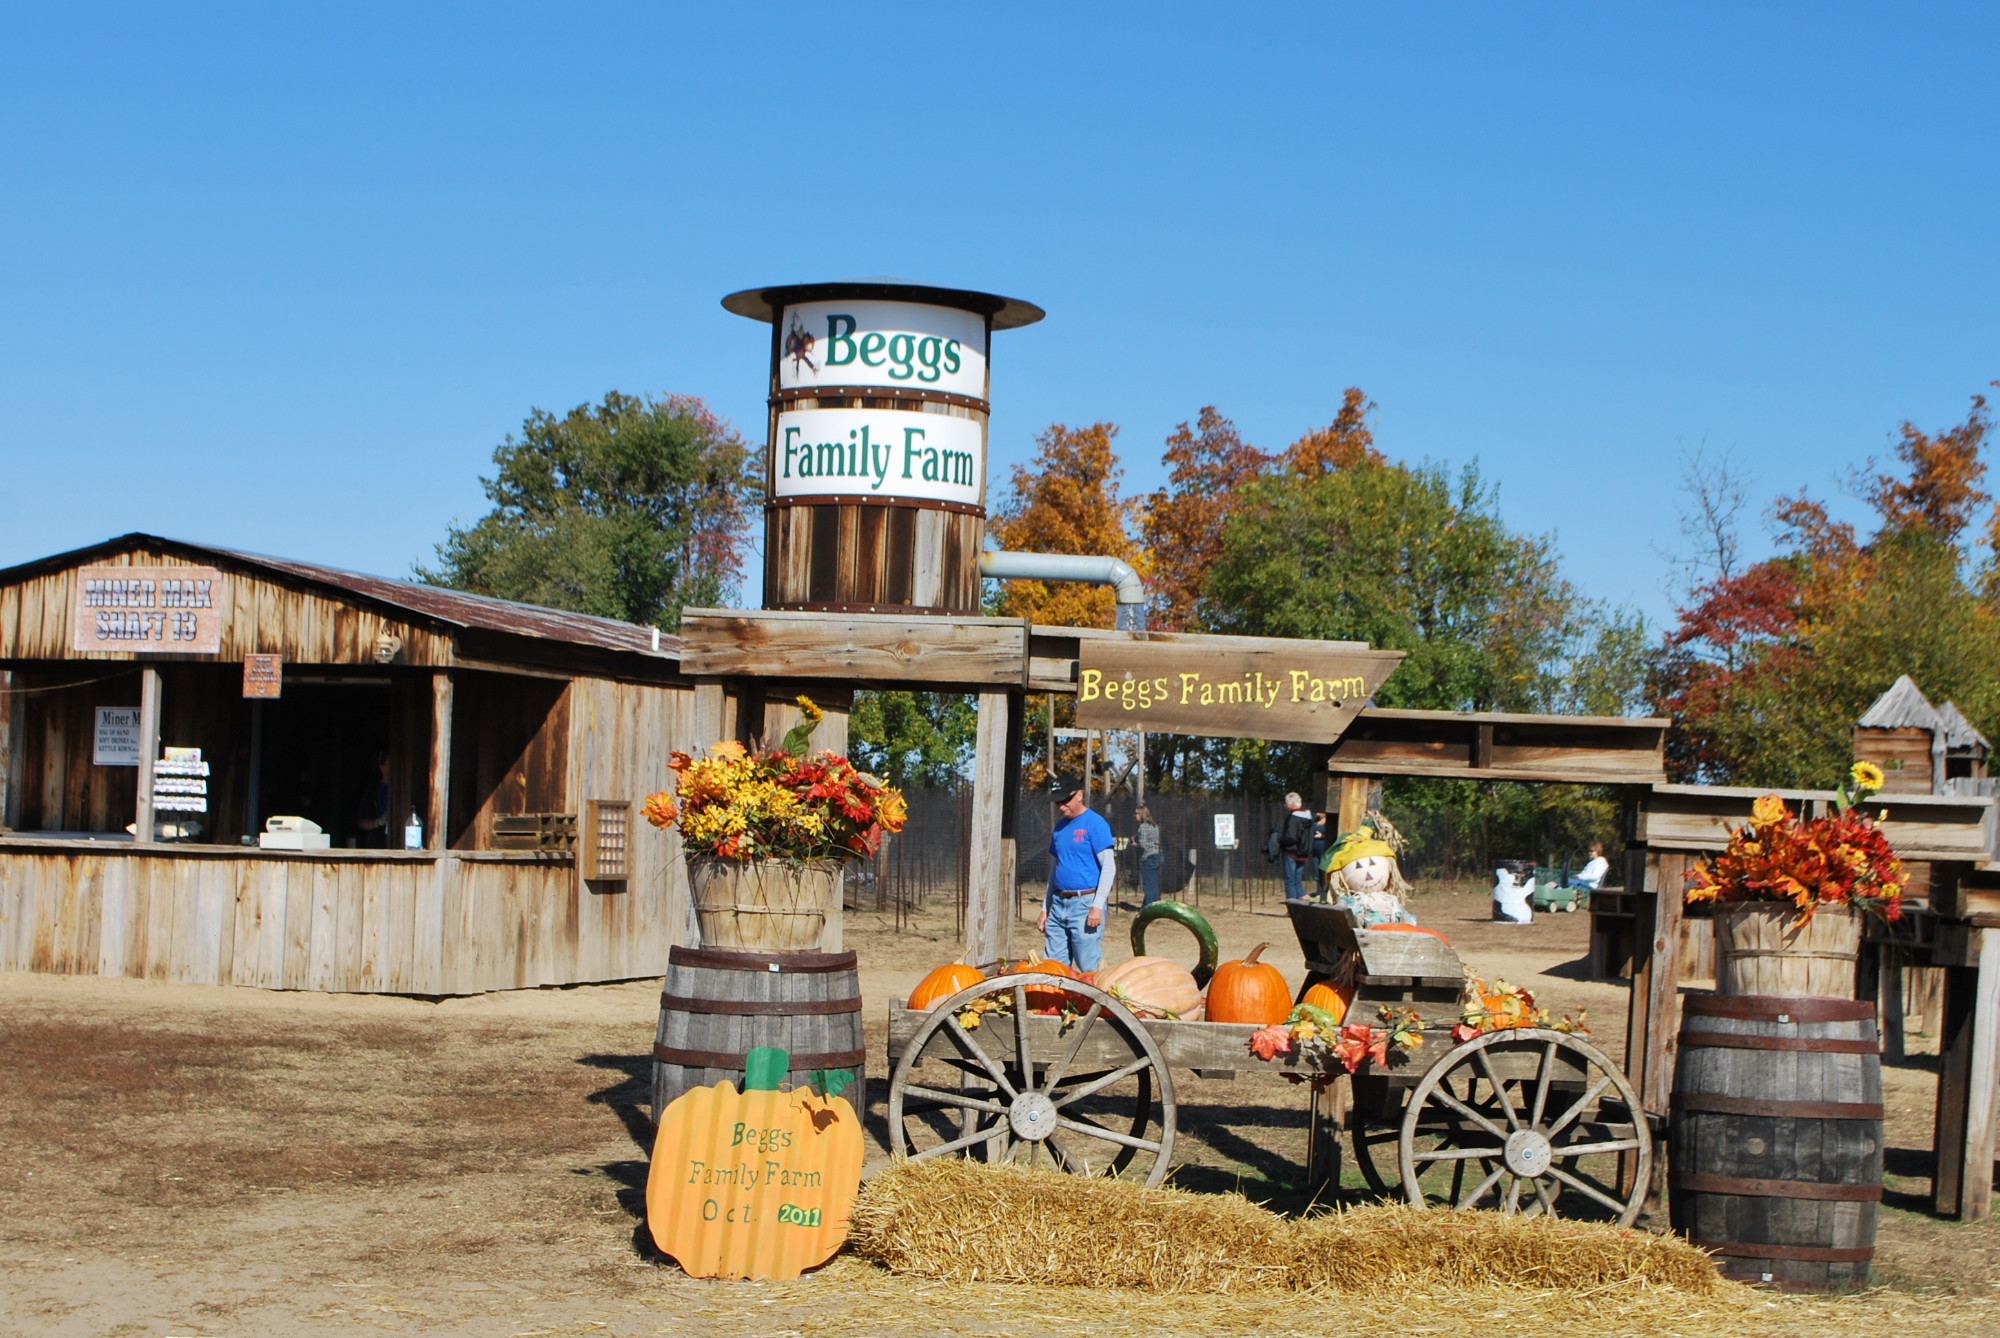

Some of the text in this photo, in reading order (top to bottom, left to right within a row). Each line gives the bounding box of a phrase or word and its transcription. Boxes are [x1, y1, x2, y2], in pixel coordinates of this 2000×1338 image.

[825, 314, 961, 382] Beggs
[783, 424, 974, 491] Family Farm
[84, 578, 213, 608] MINER MAX
[95, 610, 198, 642] SHAFT 13
[1080, 669, 1367, 710] Beggs Family Farm
[102, 711, 129, 725] Miner
[730, 1121, 793, 1154] Beggs
[688, 1160, 822, 1192] Family Farm
[702, 1198, 820, 1227] Oct. 2011
